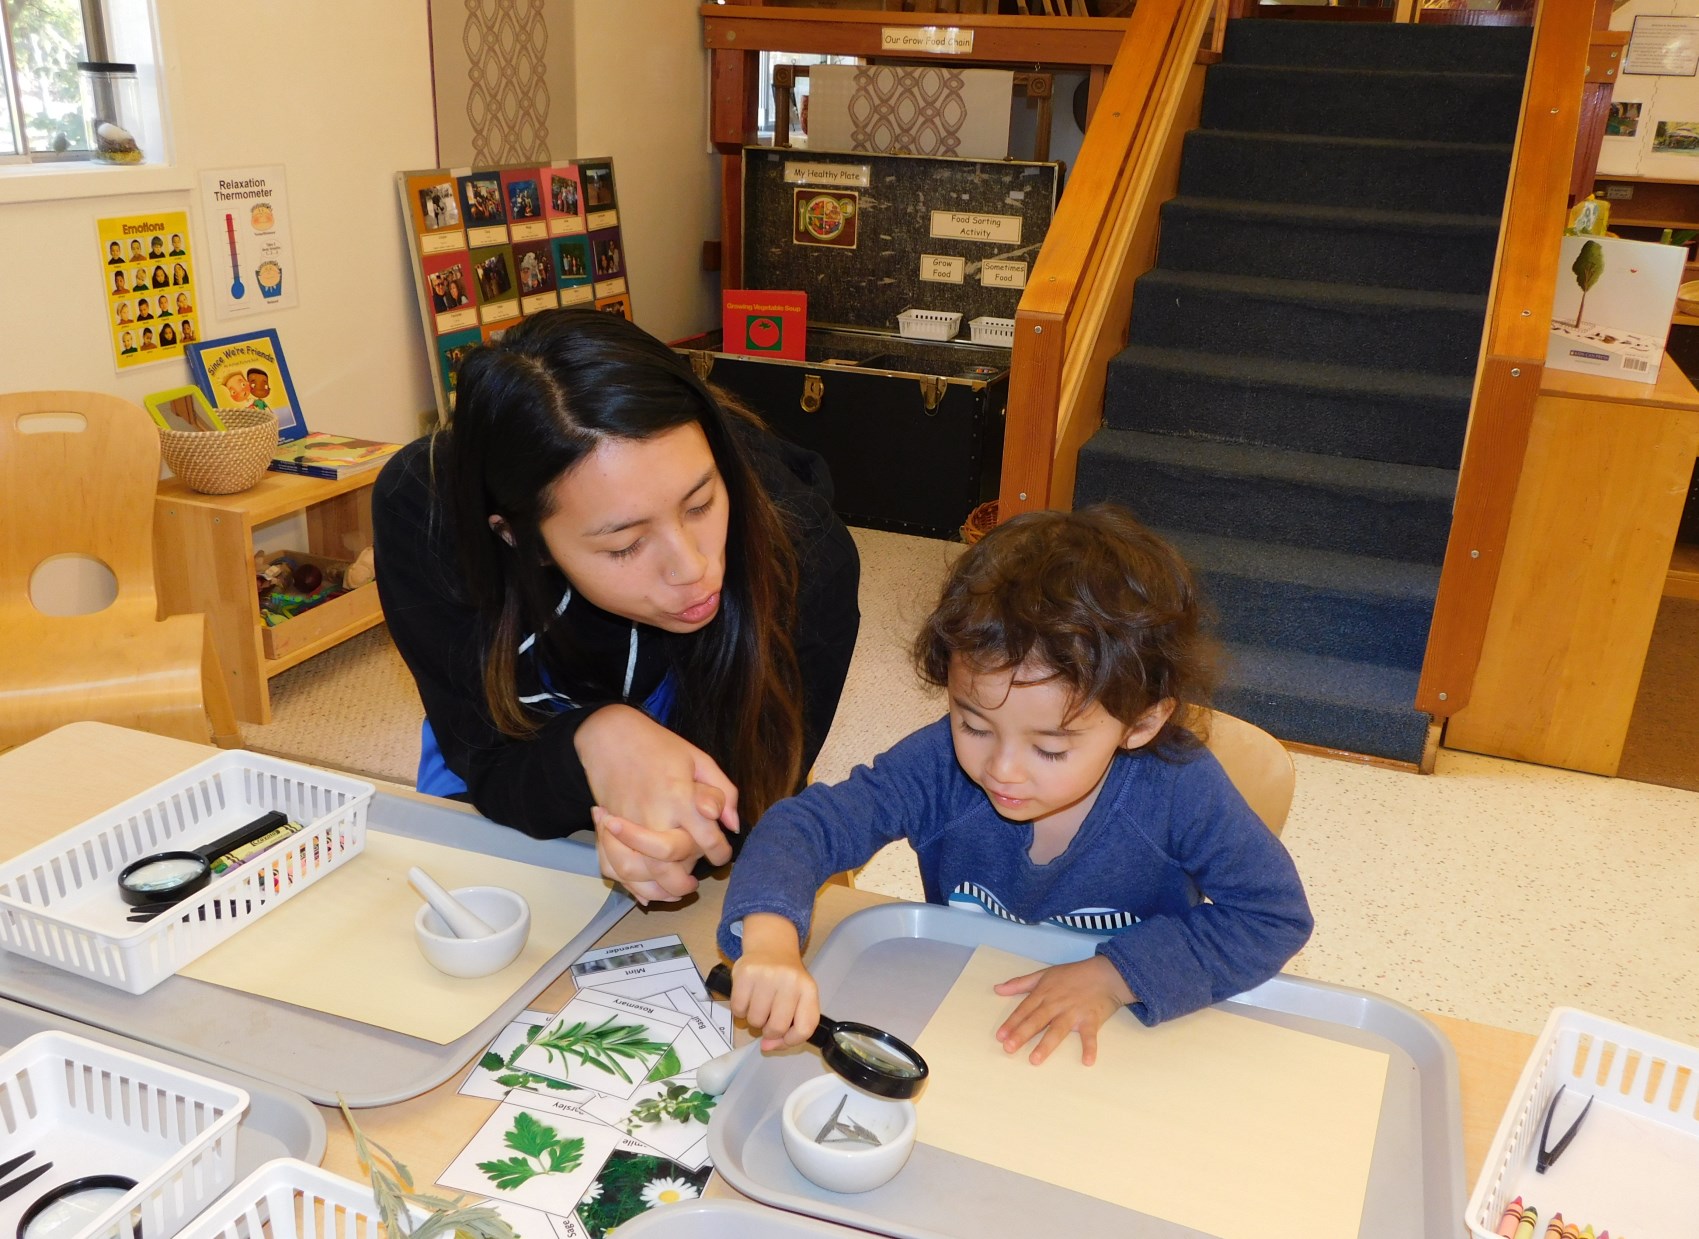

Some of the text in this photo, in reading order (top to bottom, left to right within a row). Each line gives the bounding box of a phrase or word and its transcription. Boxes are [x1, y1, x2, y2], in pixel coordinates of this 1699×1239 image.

[884, 35, 970, 47] Our Grow Food Chain
[793, 168, 860, 181] My Healthy Plate
[219, 178, 266, 190] Relaxation
[214, 189, 273, 201] Thermometer
[951, 214, 1001, 227] Food Sorting
[122, 222, 165, 235] Emotions
[960, 227, 991, 239] Activity
[932, 258, 953, 267] Grow
[985, 262, 1025, 272] Sometimes
[932, 269, 952, 278] Food
[994, 273, 1013, 282] Food
[726, 303, 753, 311] Growing
[784, 305, 801, 313] Soup
[208, 356, 224, 376] Since
[223, 346, 245, 360] We're
[246, 345, 275, 363] Friends
[605, 943, 644, 955] Lavender
[625, 967, 646, 976] Mint
[613, 998, 655, 1014] Rosemary
[691, 1015, 707, 1030] Basil
[563, 1219, 577, 1238] Sage
